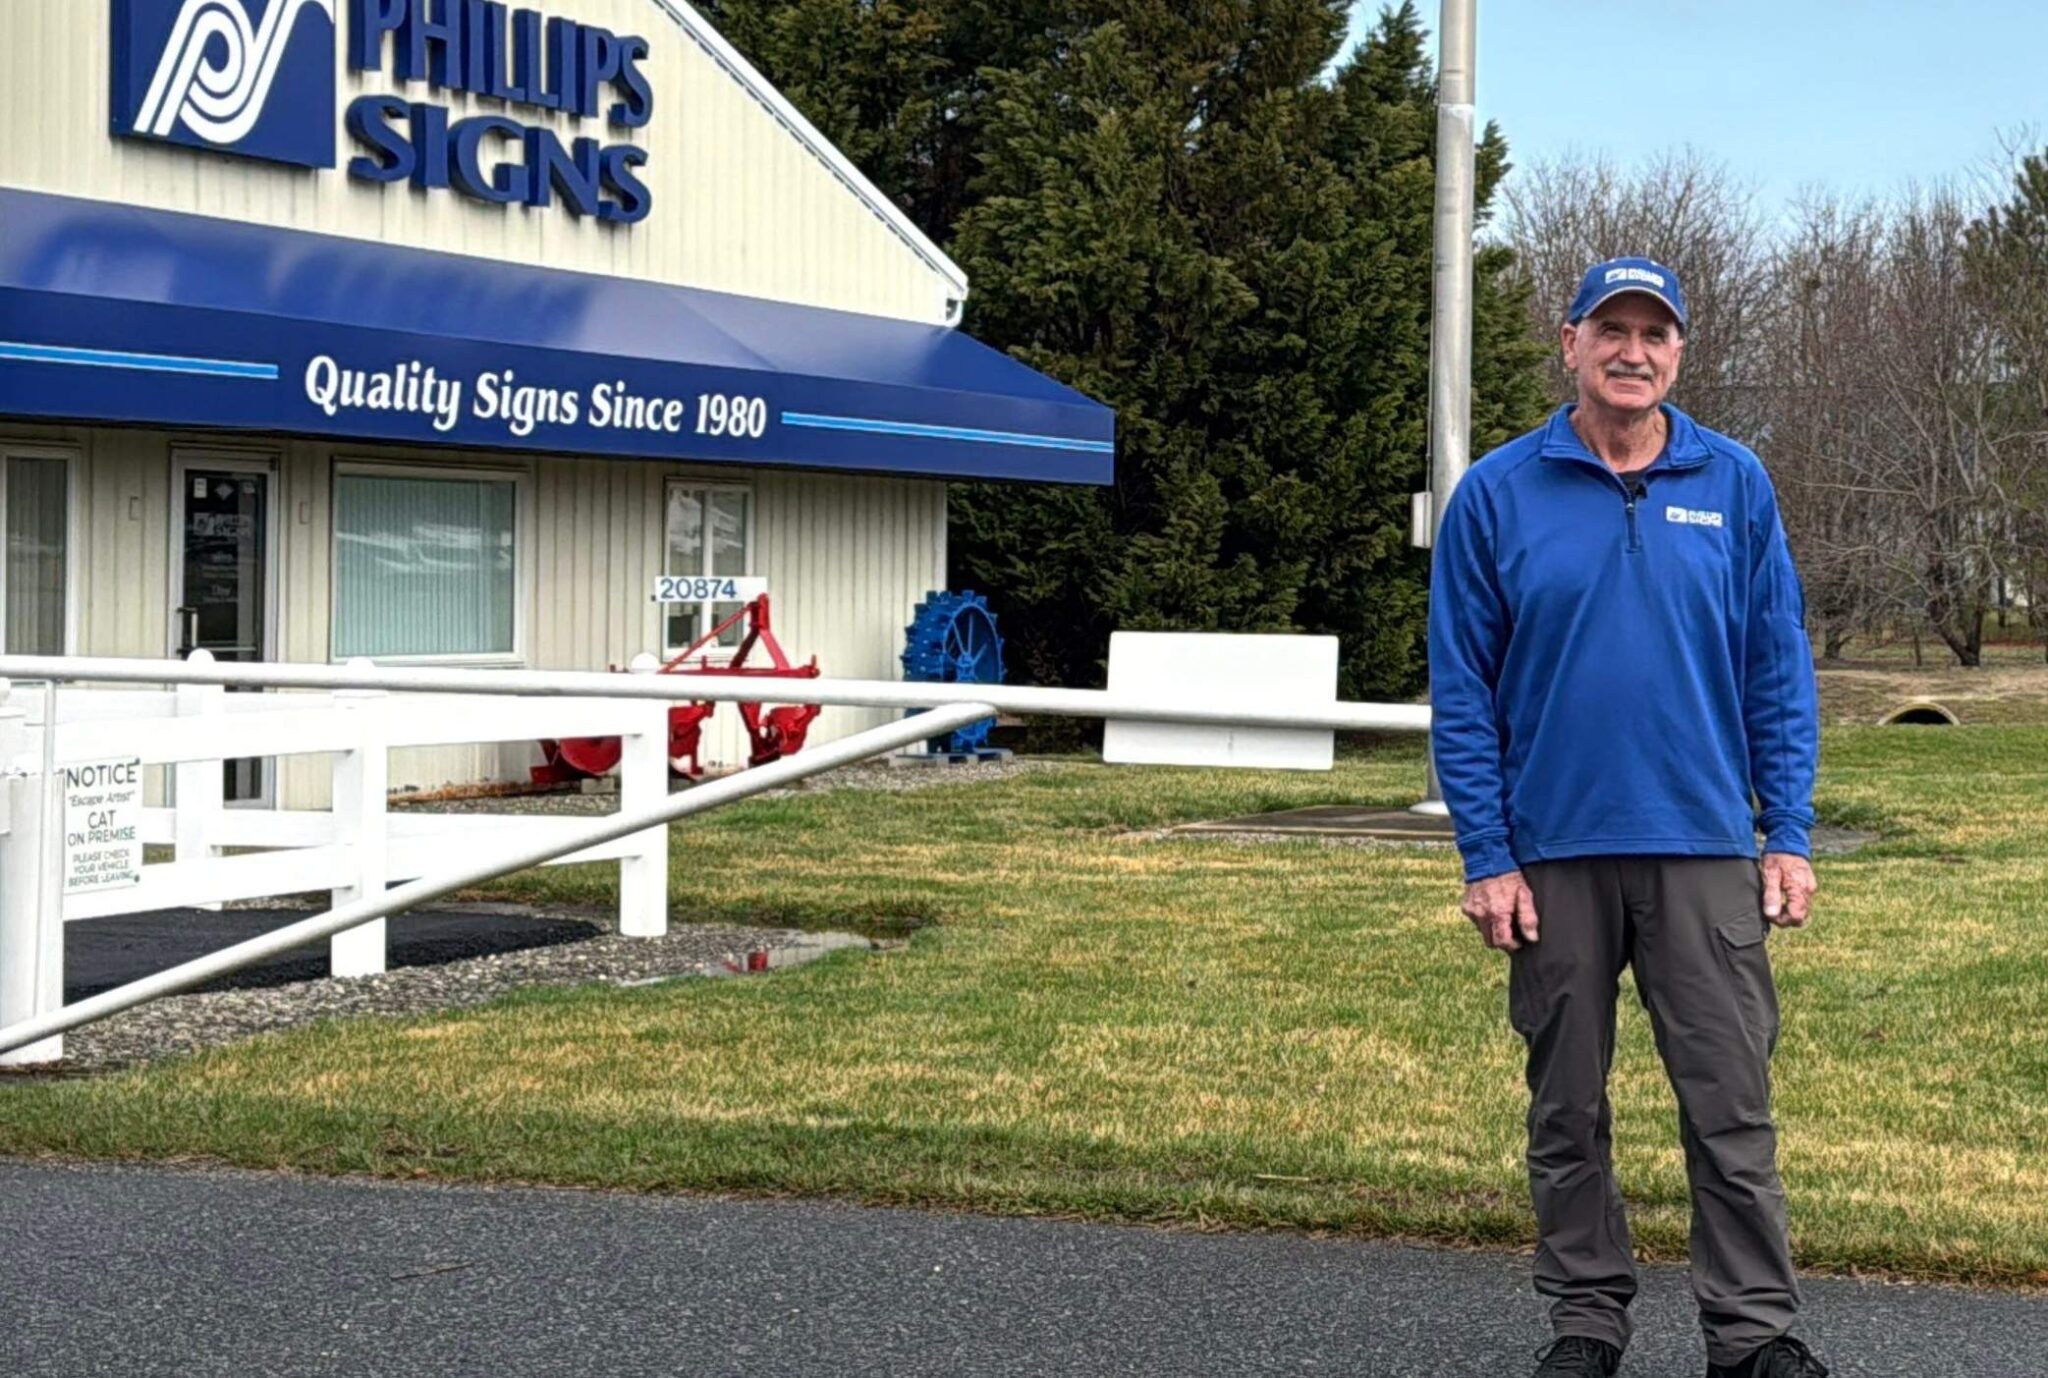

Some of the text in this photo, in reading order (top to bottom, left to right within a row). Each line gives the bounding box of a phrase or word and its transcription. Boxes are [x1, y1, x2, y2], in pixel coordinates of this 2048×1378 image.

[345, 0, 656, 128] PHILLIPS
[346, 94, 655, 224] SIGNS
[304, 355, 768, 438] Quality Signs Since 1980
[660, 578, 737, 599] 20874
[66, 763, 137, 788] NOTICE
[87, 810, 116, 829] CAT
[67, 826, 136, 847] ON PREMISE
[73, 848, 130, 864] PLEASE CHECK
[74, 860, 129, 875] YOUR VEHICLE
[68, 871, 134, 887] BEFORE LEAVING
